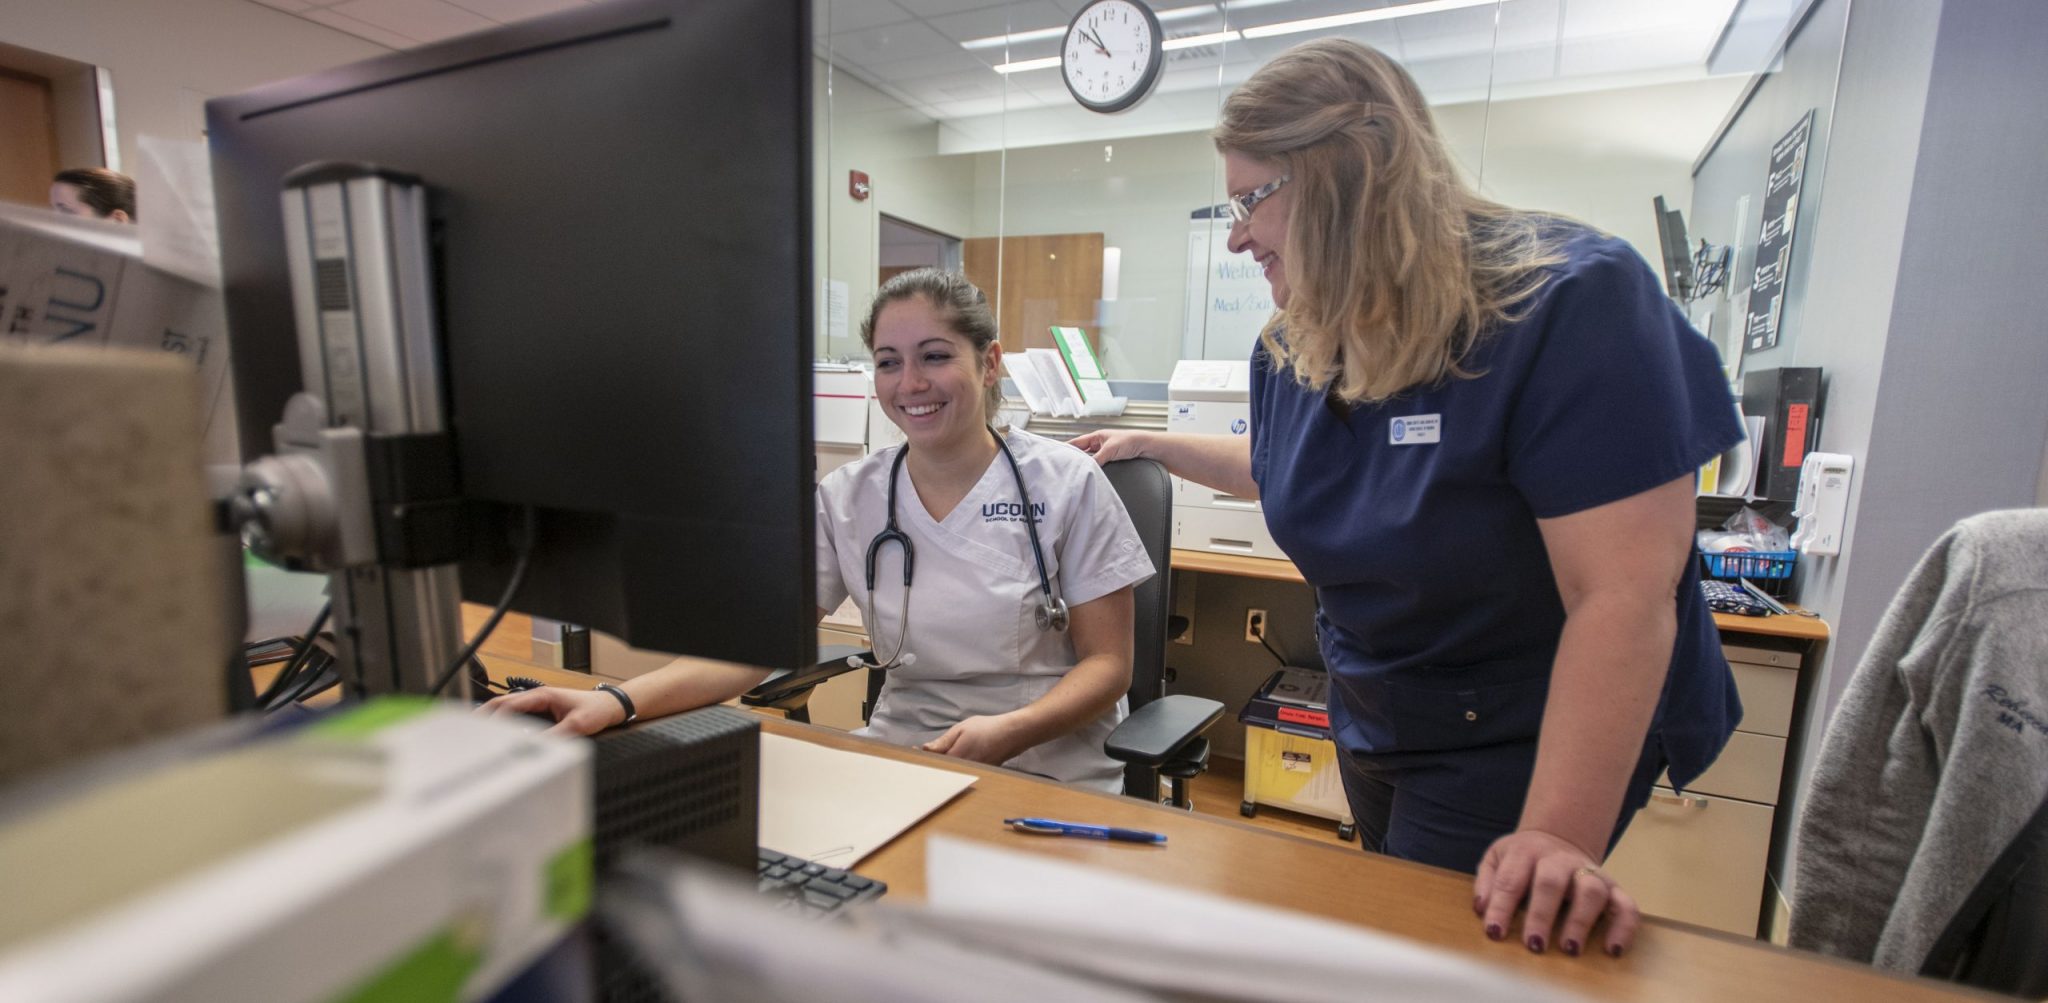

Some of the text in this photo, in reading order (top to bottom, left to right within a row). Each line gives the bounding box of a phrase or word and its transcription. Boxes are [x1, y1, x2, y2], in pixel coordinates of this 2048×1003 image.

[1103, 8, 1115, 21] 12
[1766, 171, 1776, 198] F
[1759, 219, 1769, 245] A
[1752, 265, 1762, 290] S
[1746, 311, 1755, 336] T
[1231, 418, 1247, 435] hp
[982, 502, 1046, 517] UCONN
